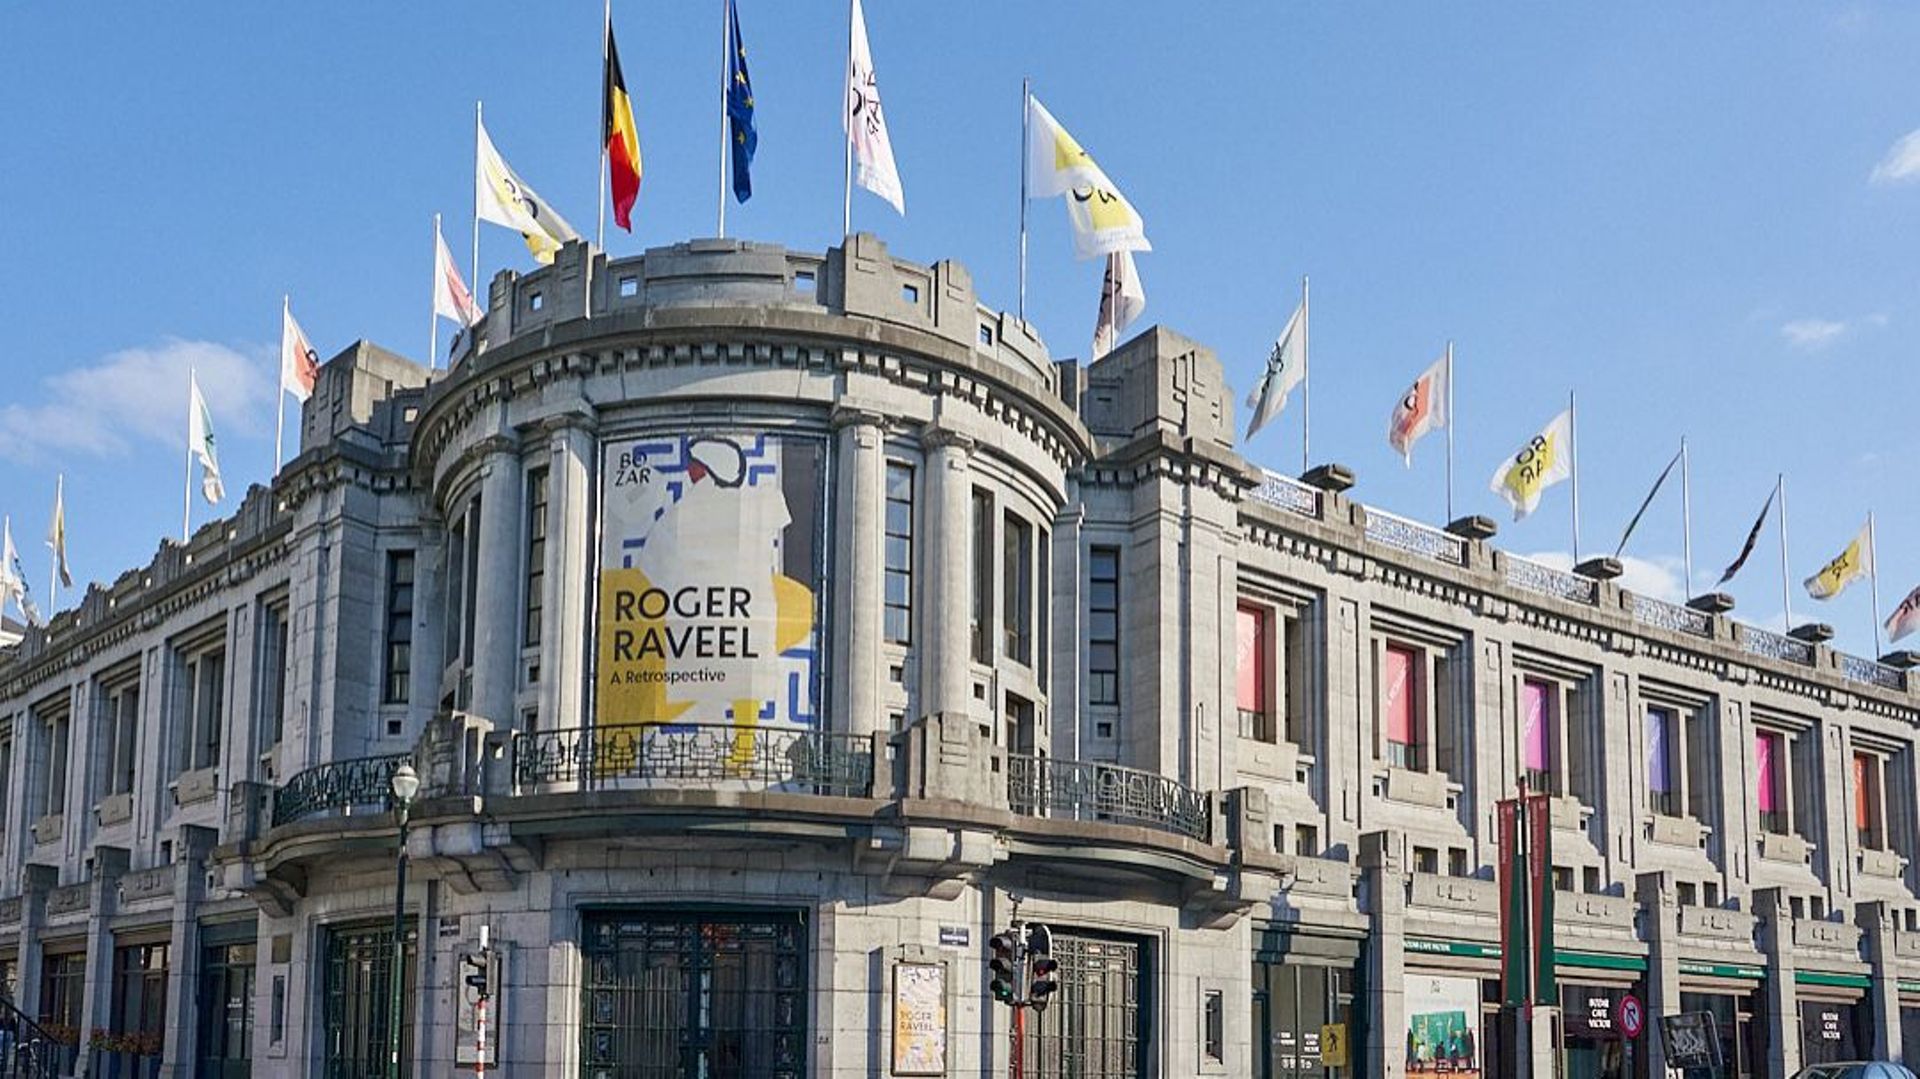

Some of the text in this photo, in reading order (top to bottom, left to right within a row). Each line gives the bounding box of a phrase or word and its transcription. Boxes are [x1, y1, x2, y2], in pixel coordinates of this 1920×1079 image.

[620, 452, 648, 469] BO
[615, 467, 651, 487] ZAR
[615, 586, 752, 622] ROGER
[614, 626, 759, 662] RAVEEL
[610, 667, 726, 685] A Retrospective
